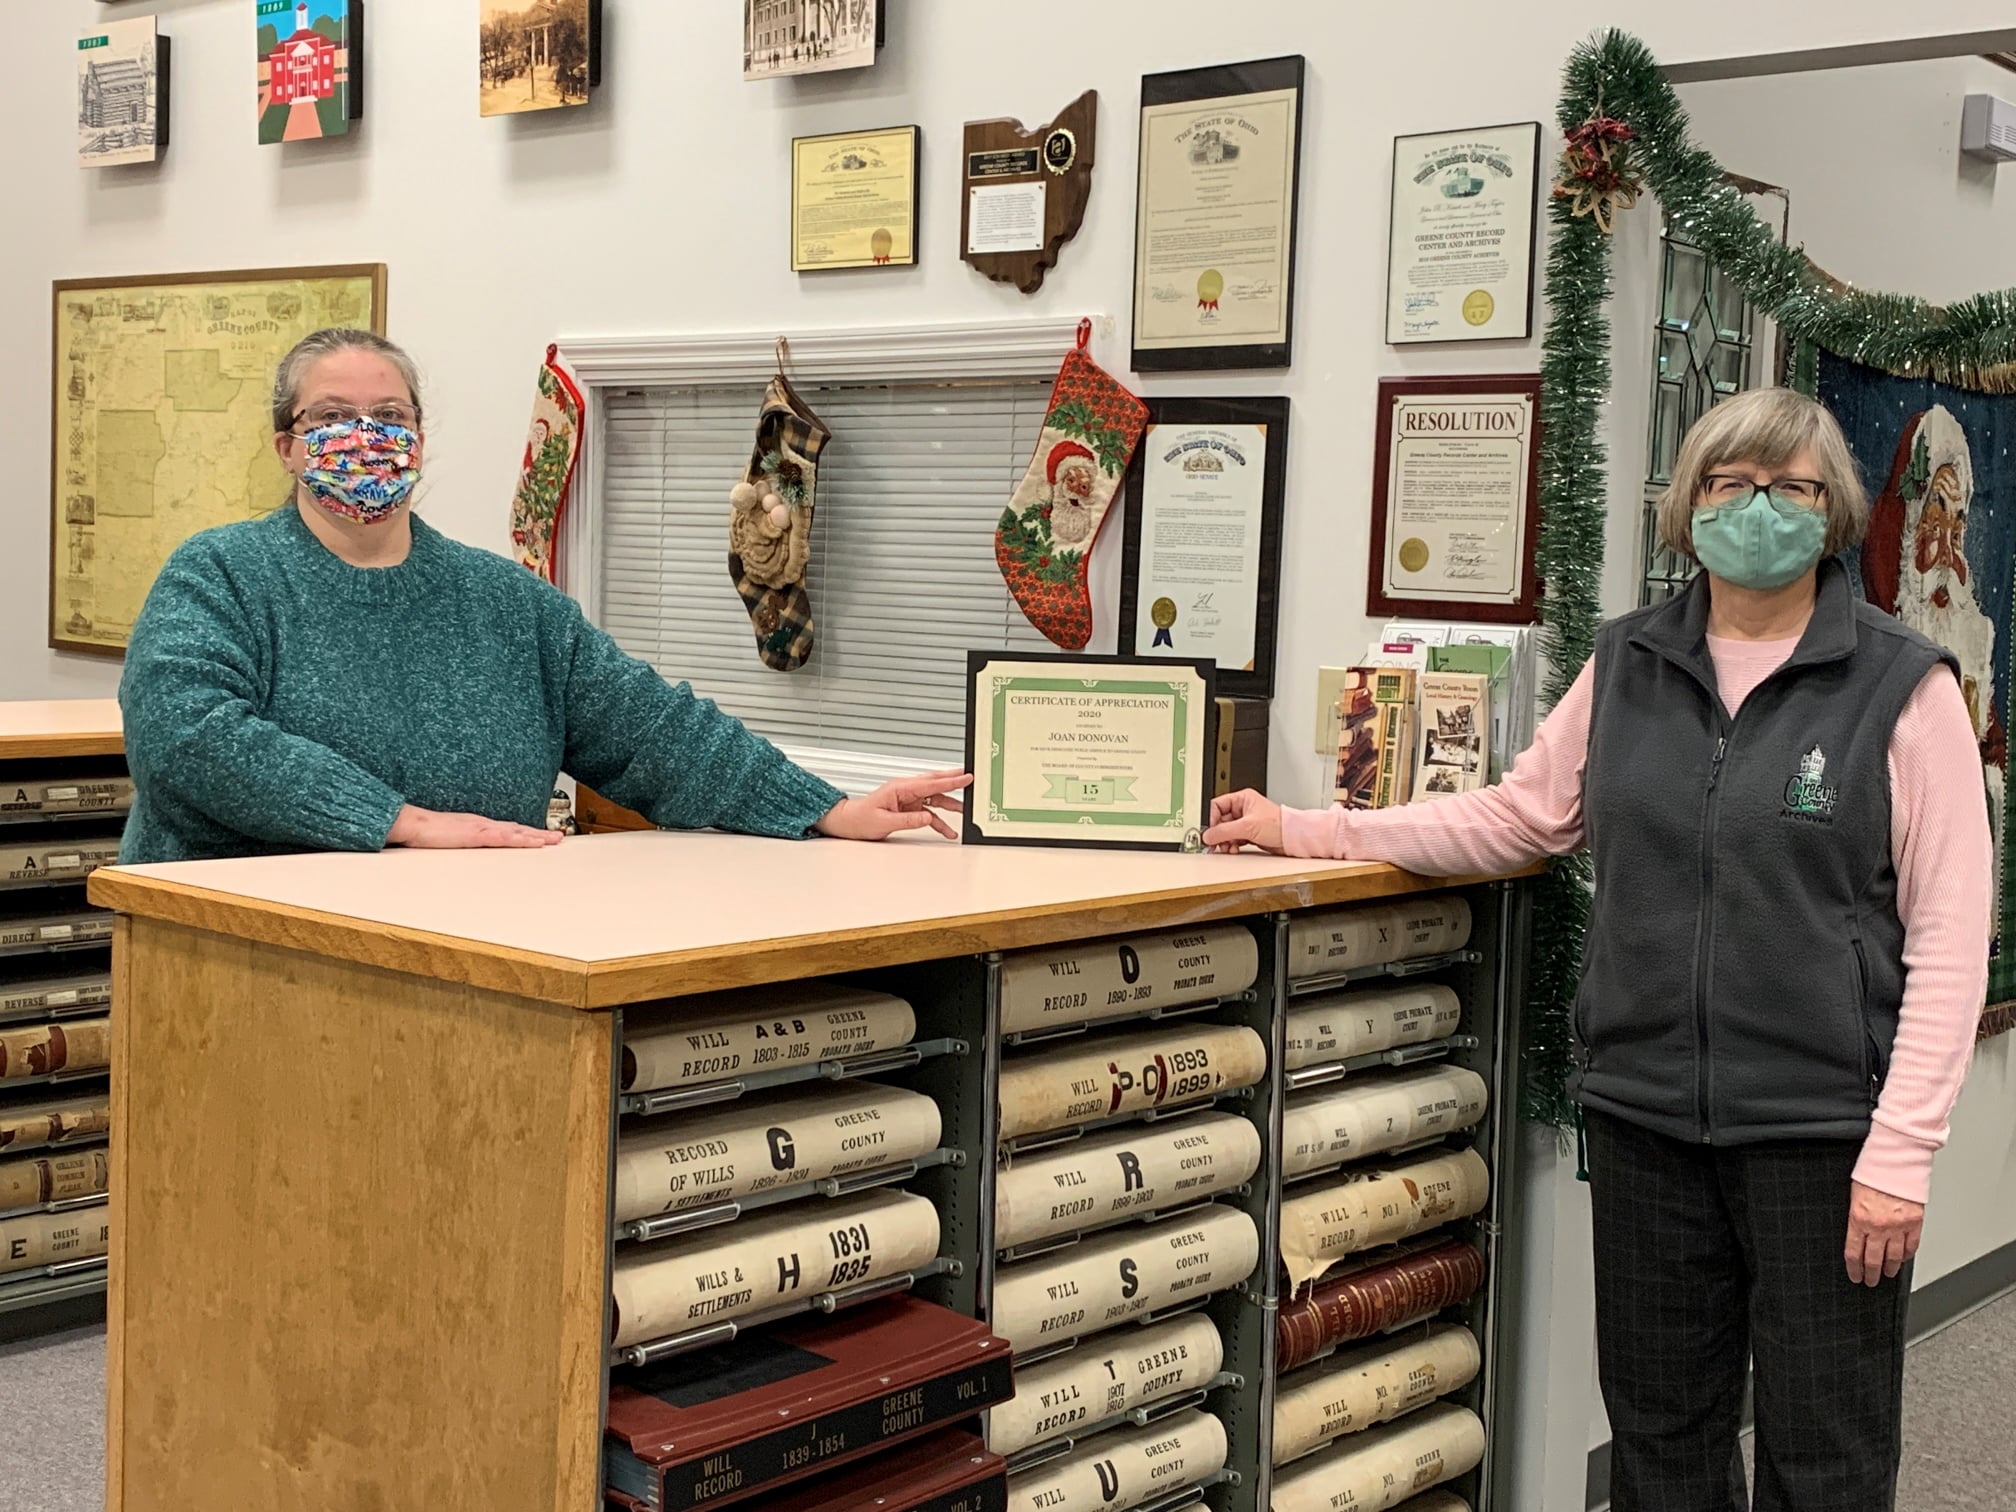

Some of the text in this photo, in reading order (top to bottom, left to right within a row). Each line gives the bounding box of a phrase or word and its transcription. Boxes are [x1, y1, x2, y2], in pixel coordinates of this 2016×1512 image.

[1415, 228, 1505, 242] GREENE COUNTY RECORD
[1418, 237, 1501, 251] CENTER AND ARCHIVES
[1405, 411, 1518, 431] RESOLUTION
[1010, 695, 1169, 710] CERTIFICATE OF APPRECIATION
[1048, 732, 1129, 744] JOAN DONOVAN
[15, 788, 28, 801] A
[79, 784, 117, 794] GREENE
[1082, 784, 1099, 795] 15
[1784, 774, 1838, 808] Greene
[78, 797, 117, 807] COUNTY
[24, 856, 37, 869] A
[2, 933, 36, 945] DIRECT
[1172, 935, 1208, 949] GREENE
[1332, 933, 1344, 944] WILL
[1379, 927, 1388, 944] X
[1049, 961, 1081, 977] WILL
[1178, 955, 1211, 969] COUNTY
[5, 997, 45, 1010] REVERSE
[1043, 992, 1088, 1011] RECORD
[827, 1010, 866, 1025] GREENE
[1365, 1019, 1374, 1034] Y
[755, 1019, 806, 1040] A & B
[830, 1025, 868, 1042] COUNTY
[1319, 1025, 1333, 1036] WILL
[686, 1031, 730, 1051] WILL
[752, 1046, 778, 1065] 1803
[1168, 1048, 1209, 1075] 1893
[681, 1055, 741, 1078] RECORD
[1071, 1078, 1099, 1097] WILL
[1170, 1072, 1210, 1098] 1899
[834, 1109, 881, 1129] GREENE
[1066, 1099, 1103, 1119] RECORD
[841, 1131, 886, 1152] COUNTY
[1335, 1127, 1348, 1138] WILL
[664, 1140, 729, 1165] RECORD
[766, 1126, 796, 1172] G
[1173, 1135, 1209, 1151] GREENE
[669, 1165, 735, 1194] OF WILLS
[1054, 1151, 1213, 1192] WILL R COUNTY
[1423, 1181, 1451, 1197] GREENE
[1050, 1197, 1094, 1220] RECORD
[1320, 1207, 1350, 1225] WILL
[1382, 1205, 1394, 1219] NO
[53, 1227, 79, 1240] GREENE
[828, 1223, 870, 1259] 1831
[1170, 1231, 1206, 1249] GREENE
[1320, 1228, 1356, 1249] RECORD
[10, 1238, 27, 1260] E
[52, 1239, 79, 1251] COUNTY
[696, 1267, 744, 1293] WILLS &
[777, 1252, 801, 1293] H
[826, 1255, 872, 1287] 1835
[1047, 1252, 1210, 1301] WILL S COUNTY
[687, 1288, 752, 1319] SETTLEMENTS
[1040, 1309, 1085, 1334] RECORD
[1137, 1345, 1189, 1374] GREENE
[1103, 1360, 1117, 1381] T
[956, 1381, 980, 1401] VOL.
[1107, 1382, 1125, 1401] 1907
[1142, 1369, 1184, 1395] COUNTY
[882, 1388, 925, 1416] GREENE
[1040, 1384, 1080, 1409] WILL
[1105, 1398, 1125, 1415] 1910
[1322, 1400, 1348, 1417] WILL
[882, 1408, 926, 1435] COUNTY
[1035, 1406, 1086, 1435] RECORD
[1319, 1415, 1352, 1436] RECORD
[810, 1423, 817, 1441] J
[1145, 1438, 1181, 1458] GREENE
[703, 1453, 733, 1477] WILL
[1151, 1458, 1184, 1479] COUNTY
[694, 1470, 743, 1501] RECORD
[1094, 1459, 1118, 1501] U
[975, 1495, 982, 1512] 2
[1032, 1488, 1066, 1510] WILL
[1330, 1490, 1355, 1508] WILL
